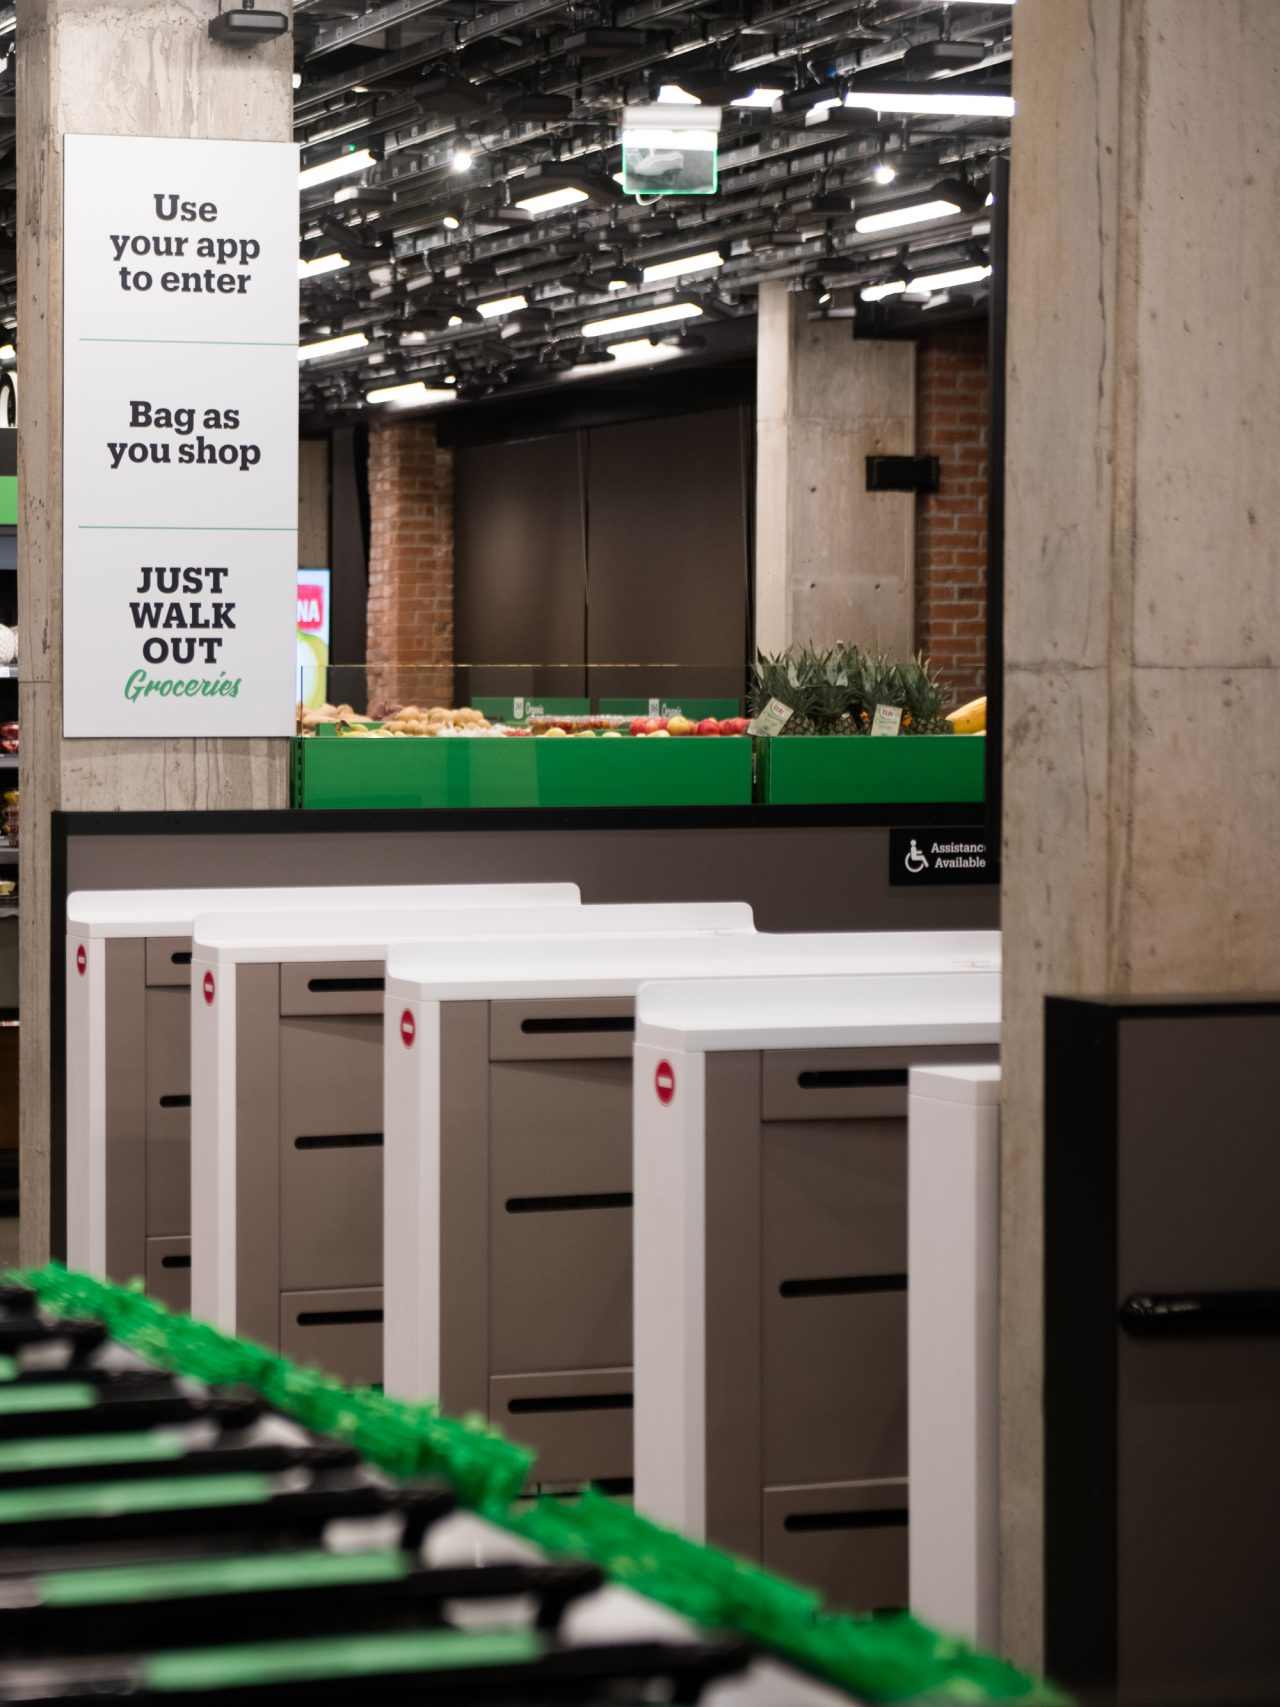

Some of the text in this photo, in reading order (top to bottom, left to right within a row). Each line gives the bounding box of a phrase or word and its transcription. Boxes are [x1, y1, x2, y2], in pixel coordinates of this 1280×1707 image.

[154, 194, 218, 222] Use
[110, 234, 261, 265] your app
[119, 267, 251, 294] to enter
[129, 400, 240, 435] Bag as
[107, 436, 261, 471] you shop
[137, 567, 229, 594] JUST
[129, 602, 236, 629] WALK
[142, 637, 223, 664] OUT
[124, 669, 242, 703] Groceries
[931, 842, 986, 853] Assistanc
[934, 857, 986, 868] Available
